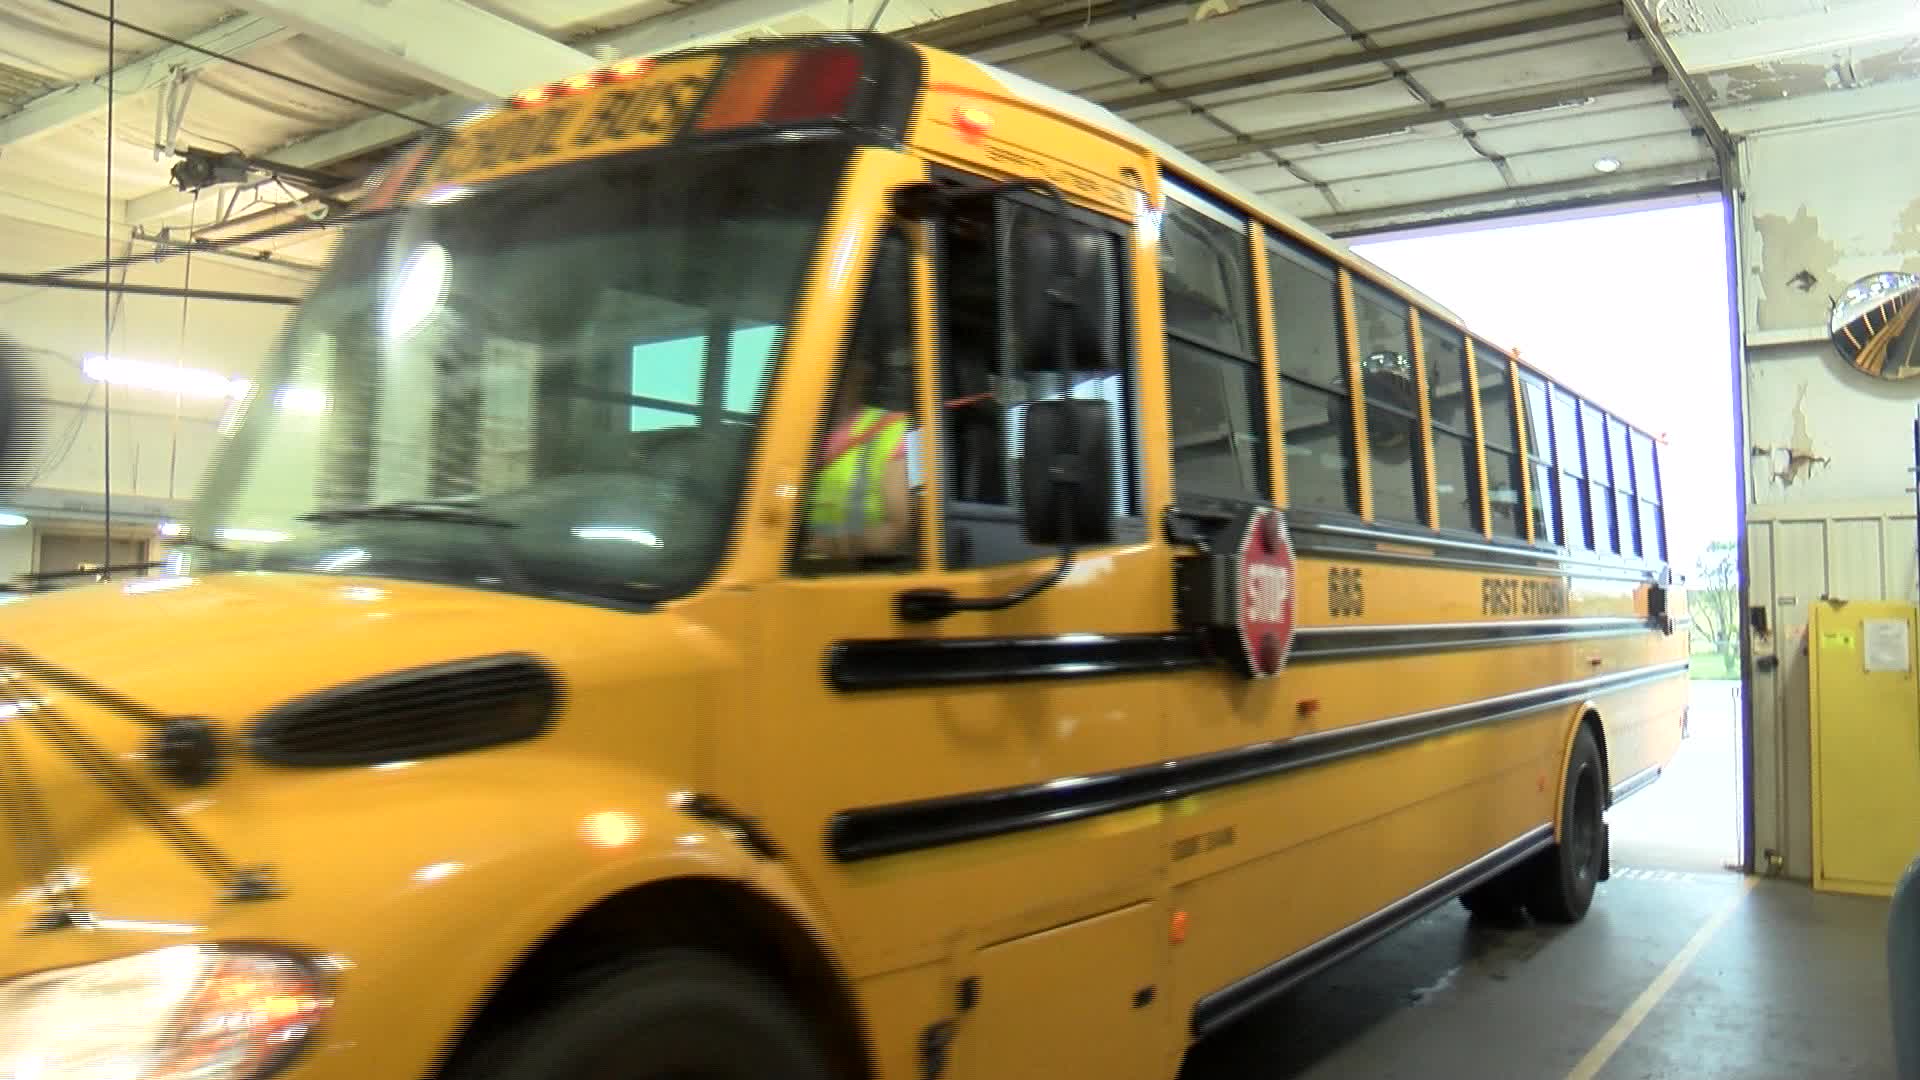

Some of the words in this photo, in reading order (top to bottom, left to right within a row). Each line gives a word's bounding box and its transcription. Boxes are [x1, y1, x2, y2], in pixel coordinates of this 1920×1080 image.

[571, 75, 703, 148] BUS
[1246, 563, 1290, 624] STOP
[1328, 567, 1365, 616] 685
[1481, 578, 1518, 615] FIRST
